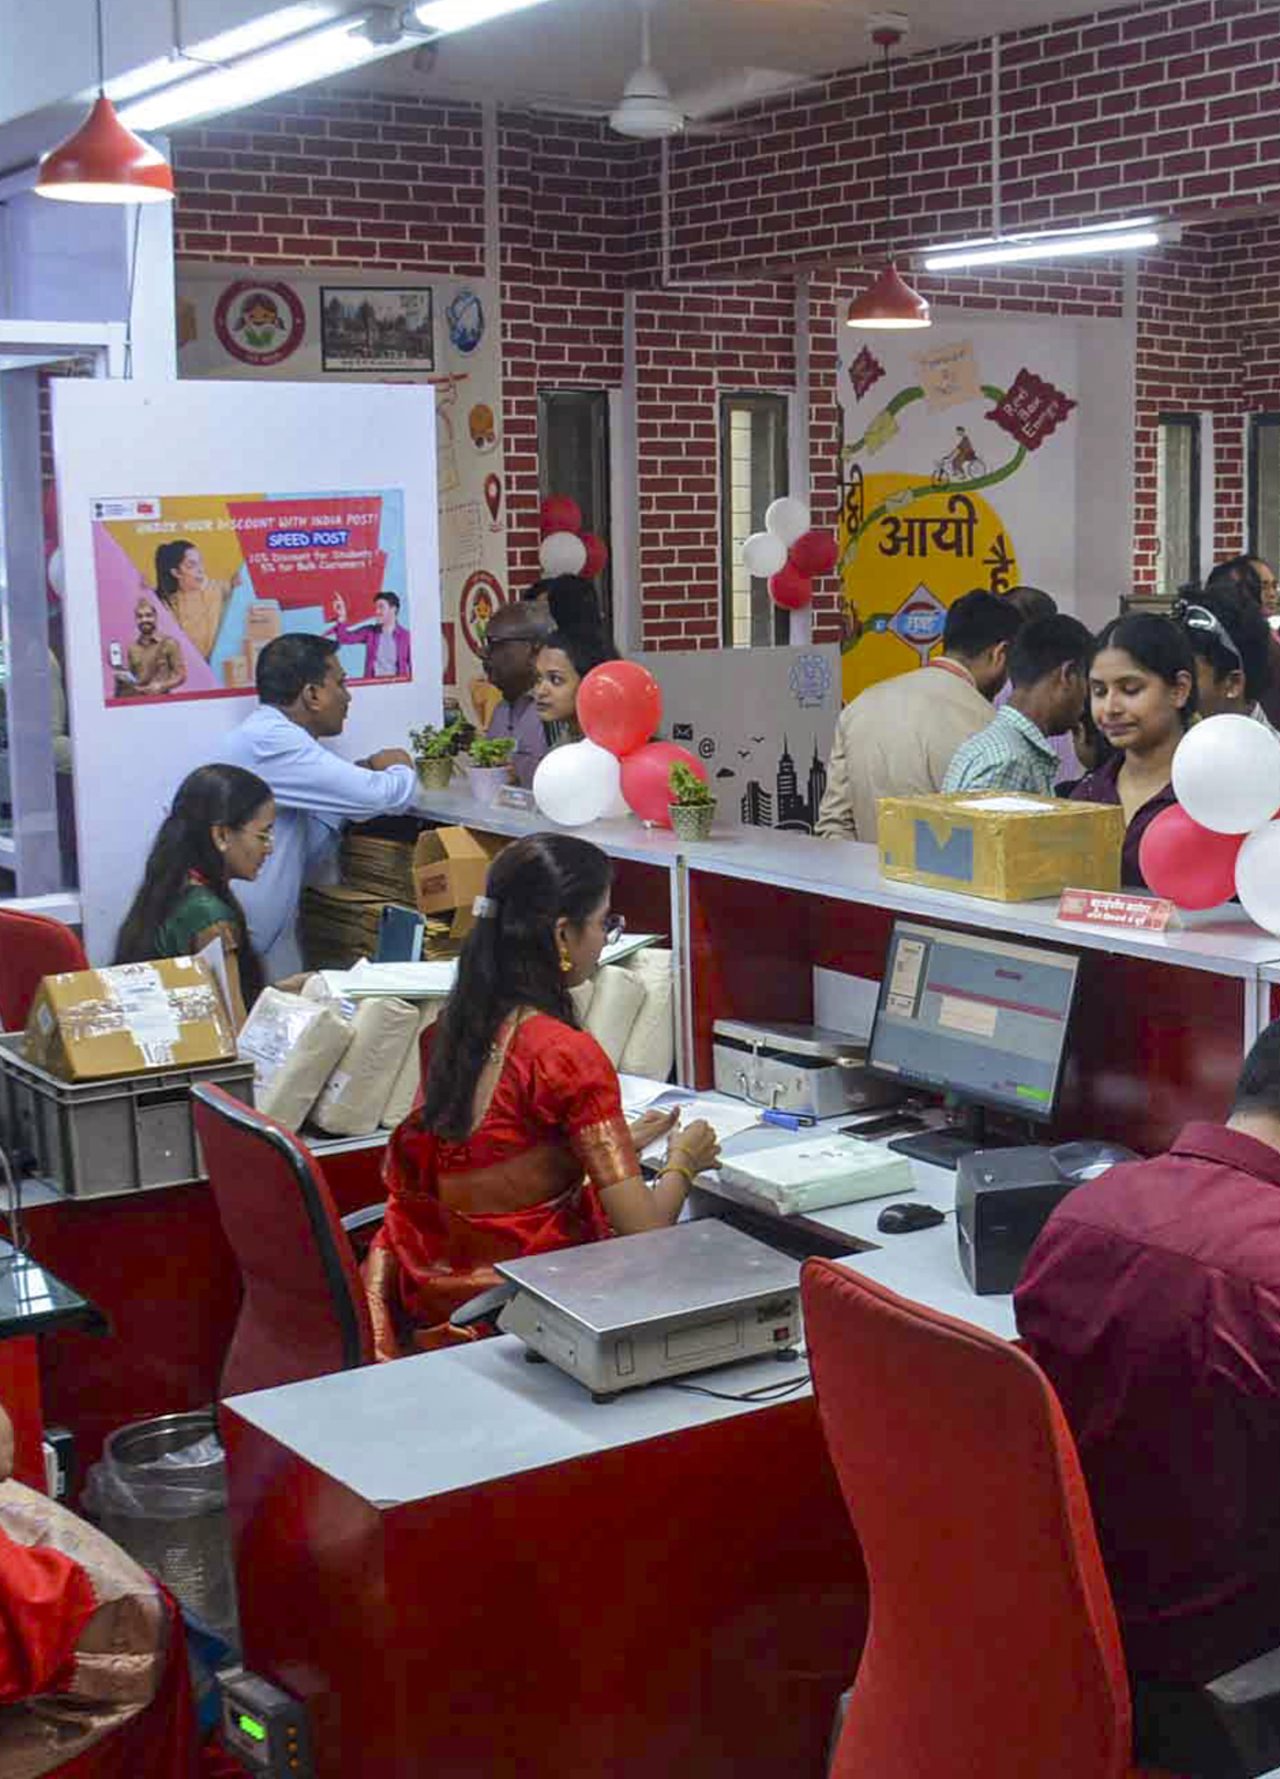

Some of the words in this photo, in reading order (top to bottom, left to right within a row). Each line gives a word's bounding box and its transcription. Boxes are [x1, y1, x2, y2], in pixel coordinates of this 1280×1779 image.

[217, 516, 275, 531] DISCOUNT
[279, 515, 307, 527] WITH
[312, 514, 342, 527] INDIA
[878, 493, 978, 558] आयी
[268, 532, 310, 547] SPEED
[313, 530, 348, 545] POST
